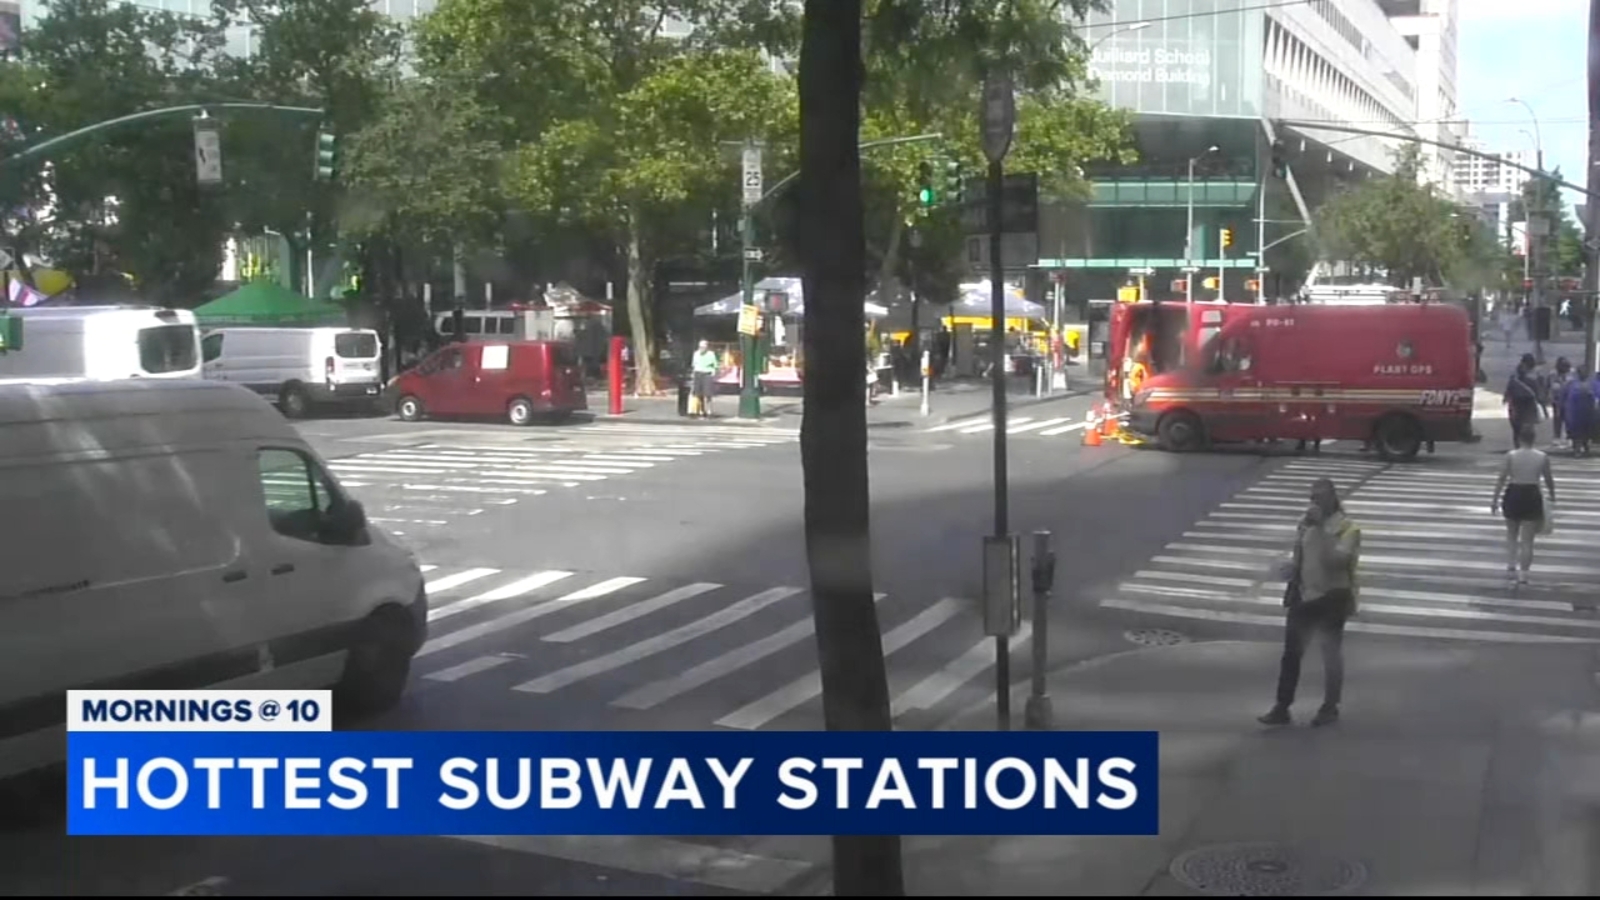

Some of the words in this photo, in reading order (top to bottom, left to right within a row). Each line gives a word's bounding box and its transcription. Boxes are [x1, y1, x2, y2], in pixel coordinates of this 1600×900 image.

[1155, 48, 1210, 65] School
[1155, 68, 1210, 87] Building
[746, 171, 760, 186] 25
[1373, 364, 1407, 374] PLANT
[1420, 389, 1454, 405] FDNY
